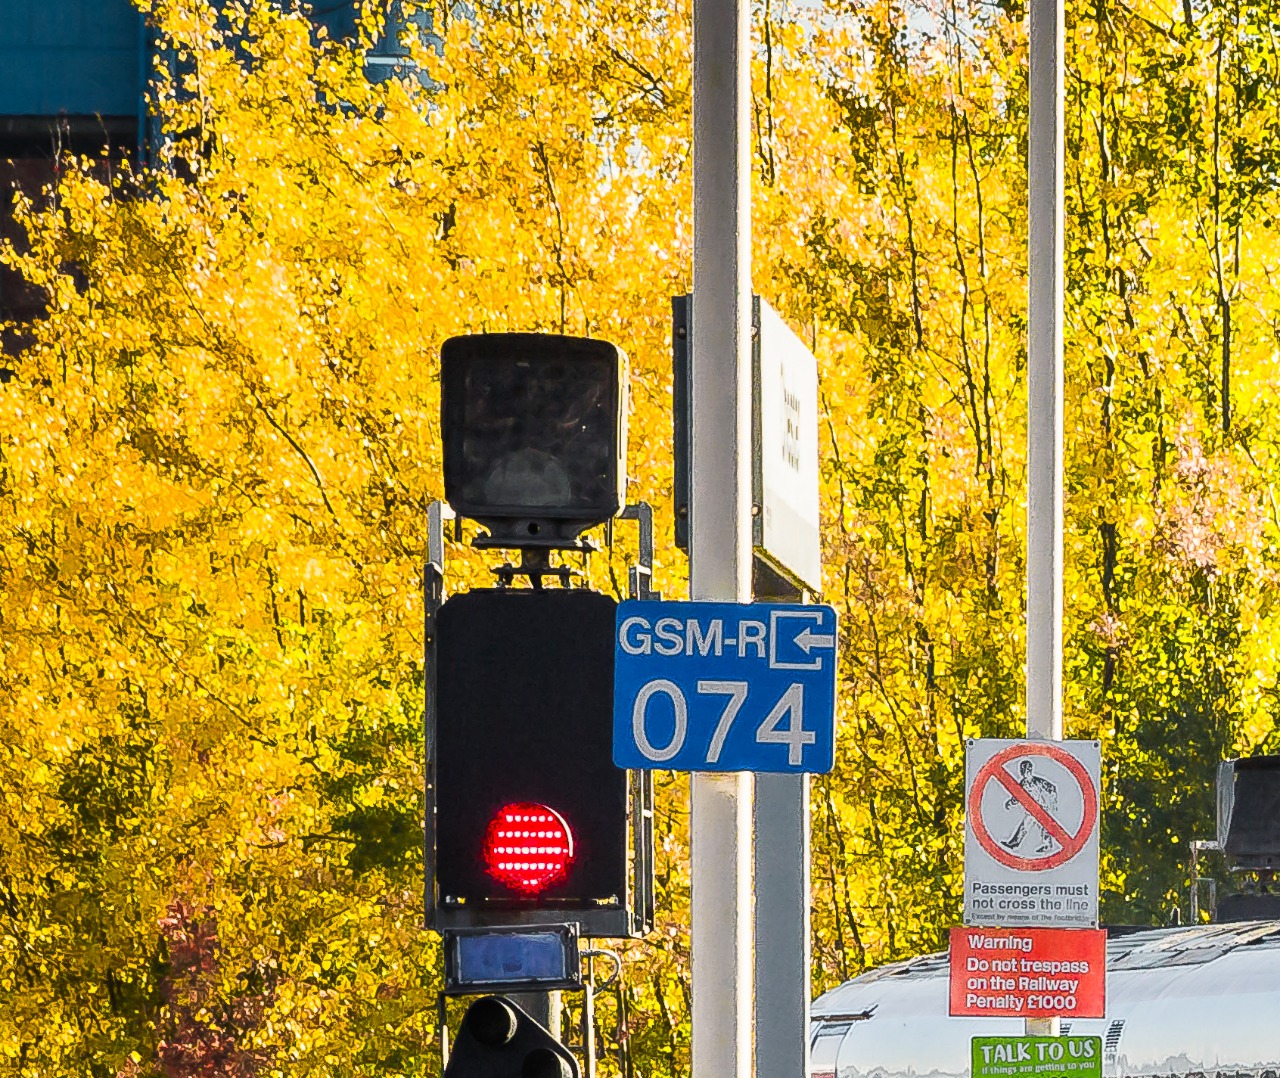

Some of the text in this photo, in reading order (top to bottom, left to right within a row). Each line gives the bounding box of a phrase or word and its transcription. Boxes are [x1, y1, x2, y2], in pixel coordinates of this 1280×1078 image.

[619, 616, 767, 658] GSM-R
[632, 679, 816, 765] 074
[972, 882, 1089, 897] Passengers must
[972, 898, 1089, 911] not cross the line
[968, 935, 1032, 951] Warning
[967, 958, 1089, 975] Do not trespass
[967, 976, 1079, 993] on the Railway
[966, 994, 1077, 1011] Penalty £1000
[981, 1039, 1094, 1064] TALK TO US
[990, 1065, 1017, 1075] things
[1020, 1065, 1033, 1073] are
[1035, 1062, 1065, 1073] getting
[1067, 1062, 1077, 1070] to
[1079, 1061, 1095, 1071] you
